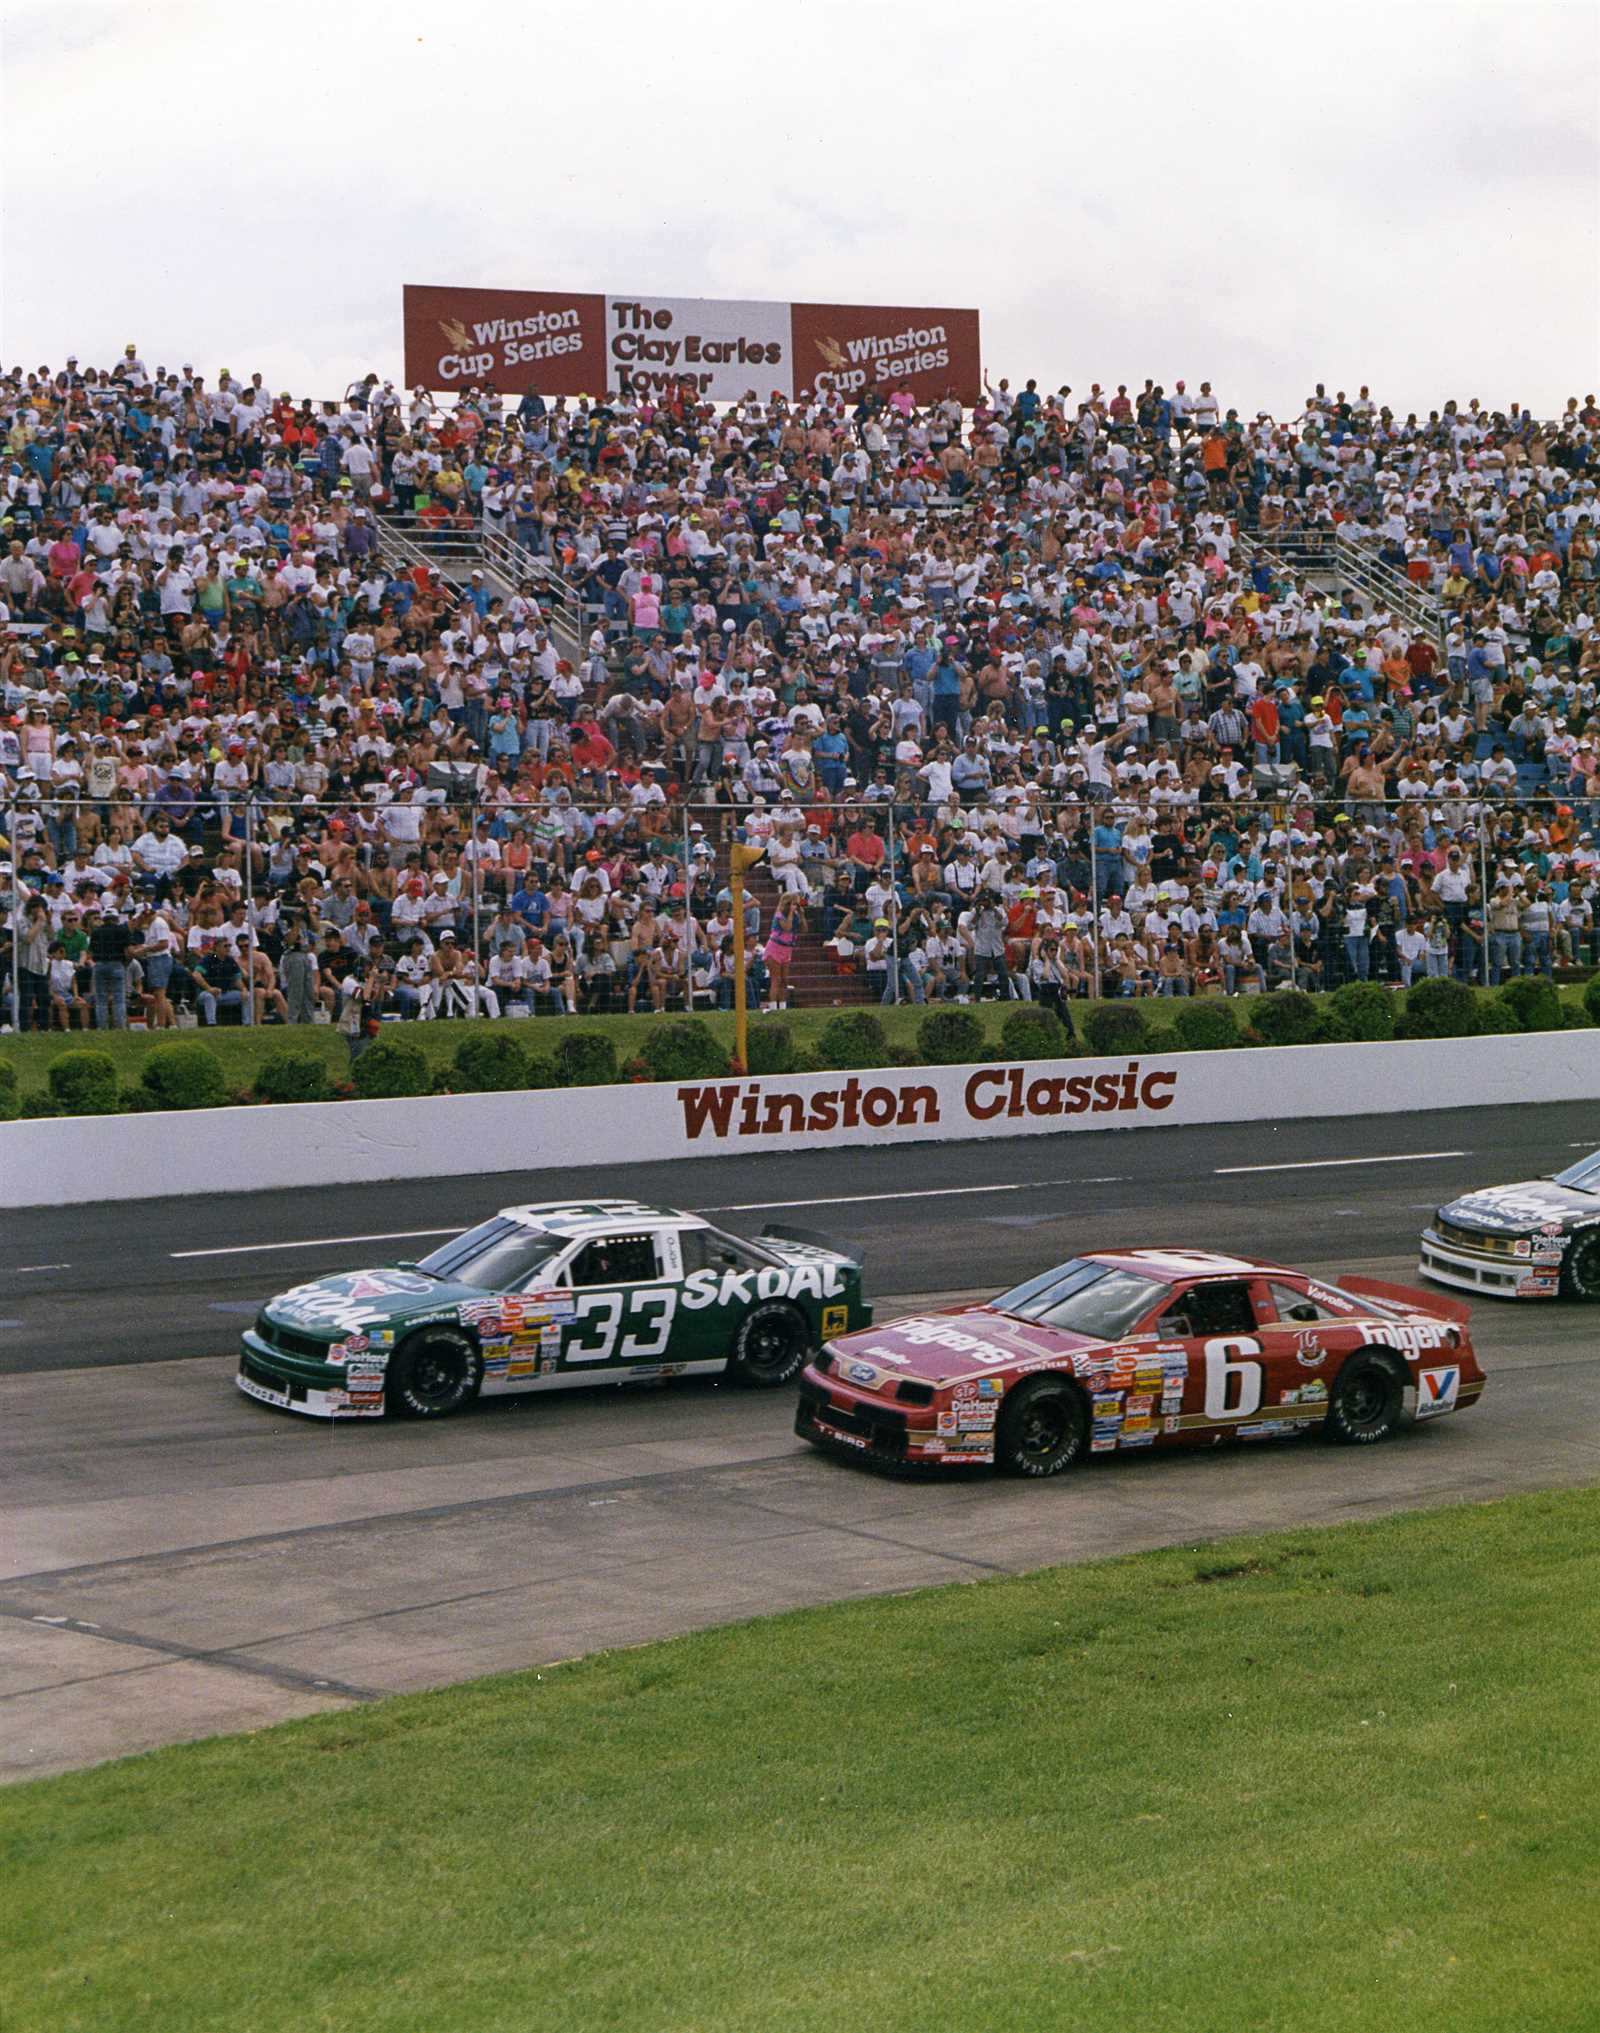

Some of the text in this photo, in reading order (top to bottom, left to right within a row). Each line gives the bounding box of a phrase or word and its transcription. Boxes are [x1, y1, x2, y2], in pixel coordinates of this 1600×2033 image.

[473, 308, 580, 346] Winston
[612, 302, 672, 330] The
[438, 332, 583, 379] Cup Series
[612, 333, 781, 366] Clay Earles
[847, 325, 947, 363] Winston
[614, 364, 713, 393] Tower
[814, 347, 949, 393] Cup Series
[678, 1062, 1177, 1139] Winston Classic
[681, 1266, 846, 1309] SKOAL
[565, 1288, 677, 1363] 33
[956, 1386, 977, 1397] STP
[1204, 1336, 1263, 1420] 6
[952, 1399, 999, 1411] DieHard
